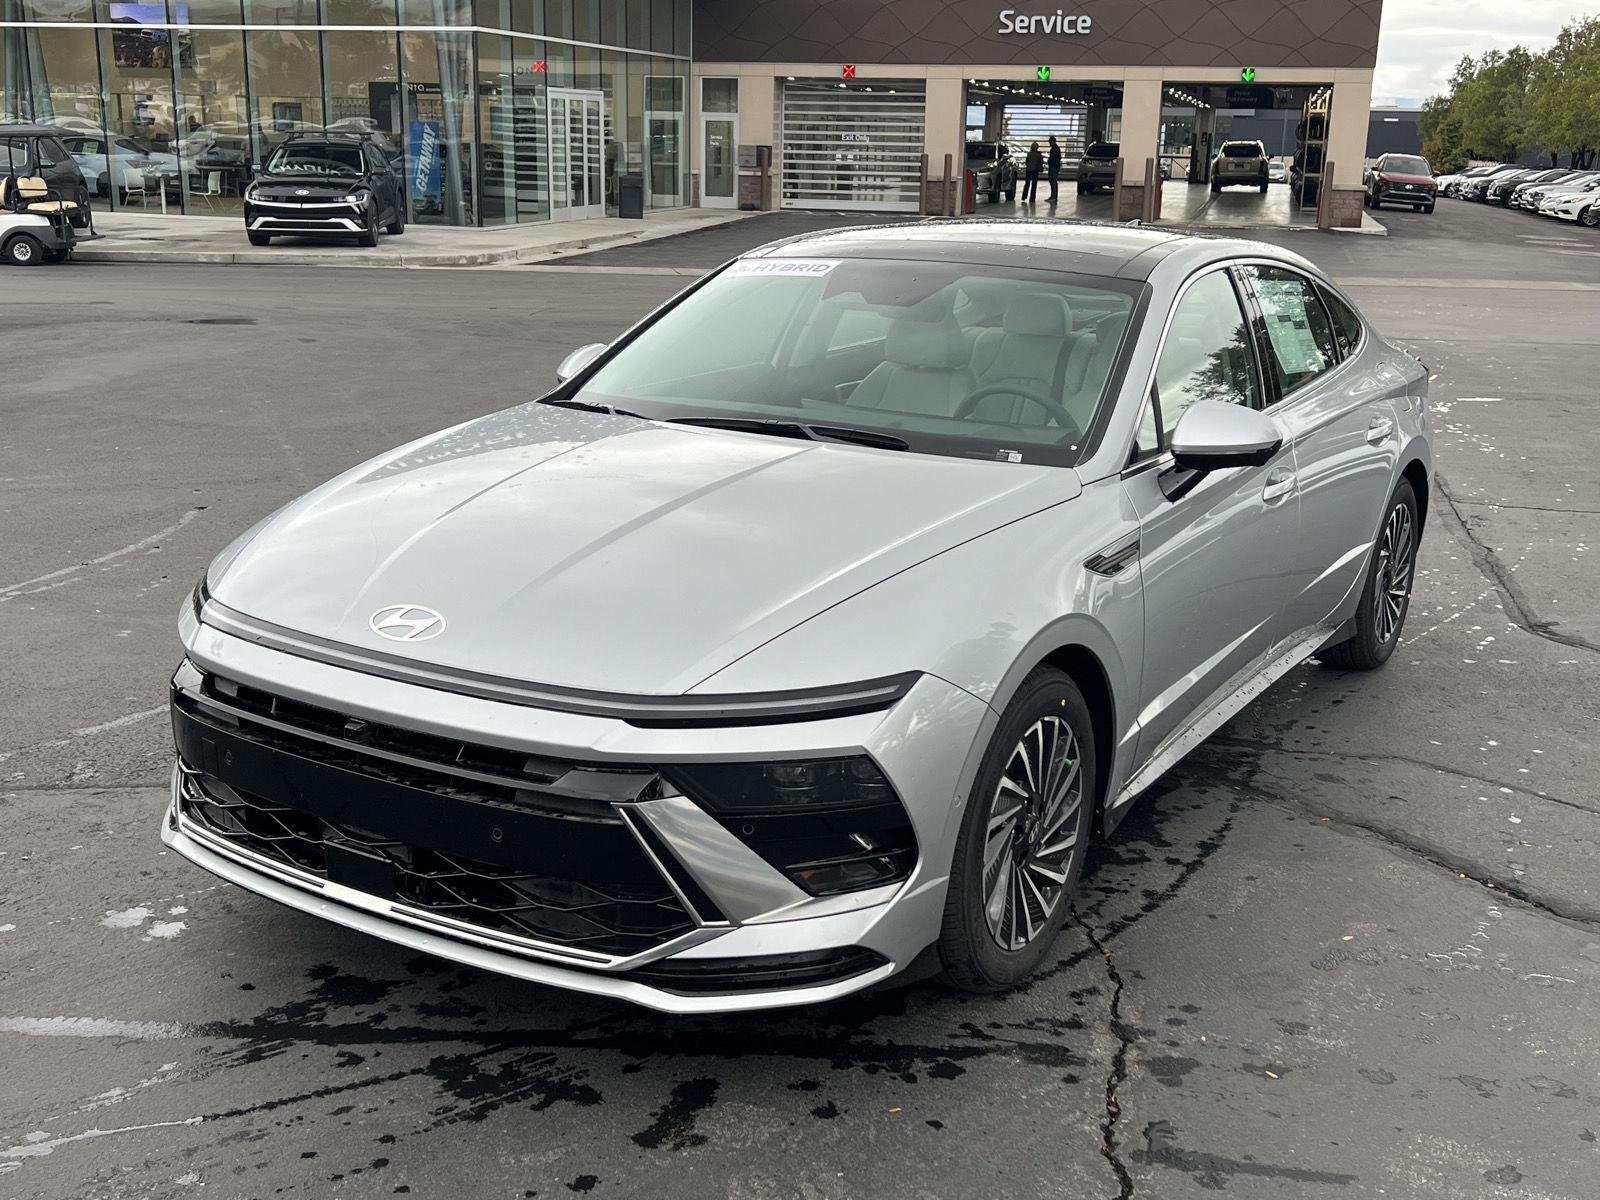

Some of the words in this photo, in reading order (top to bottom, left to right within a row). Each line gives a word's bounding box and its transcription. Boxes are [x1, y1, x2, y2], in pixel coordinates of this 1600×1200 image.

[998, 9, 1092, 34] Service
[841, 133, 855, 141] Exit
[855, 133, 870, 143] Only
[415, 123, 435, 191] GETAWAY
[753, 263, 830, 272] HYBRID
